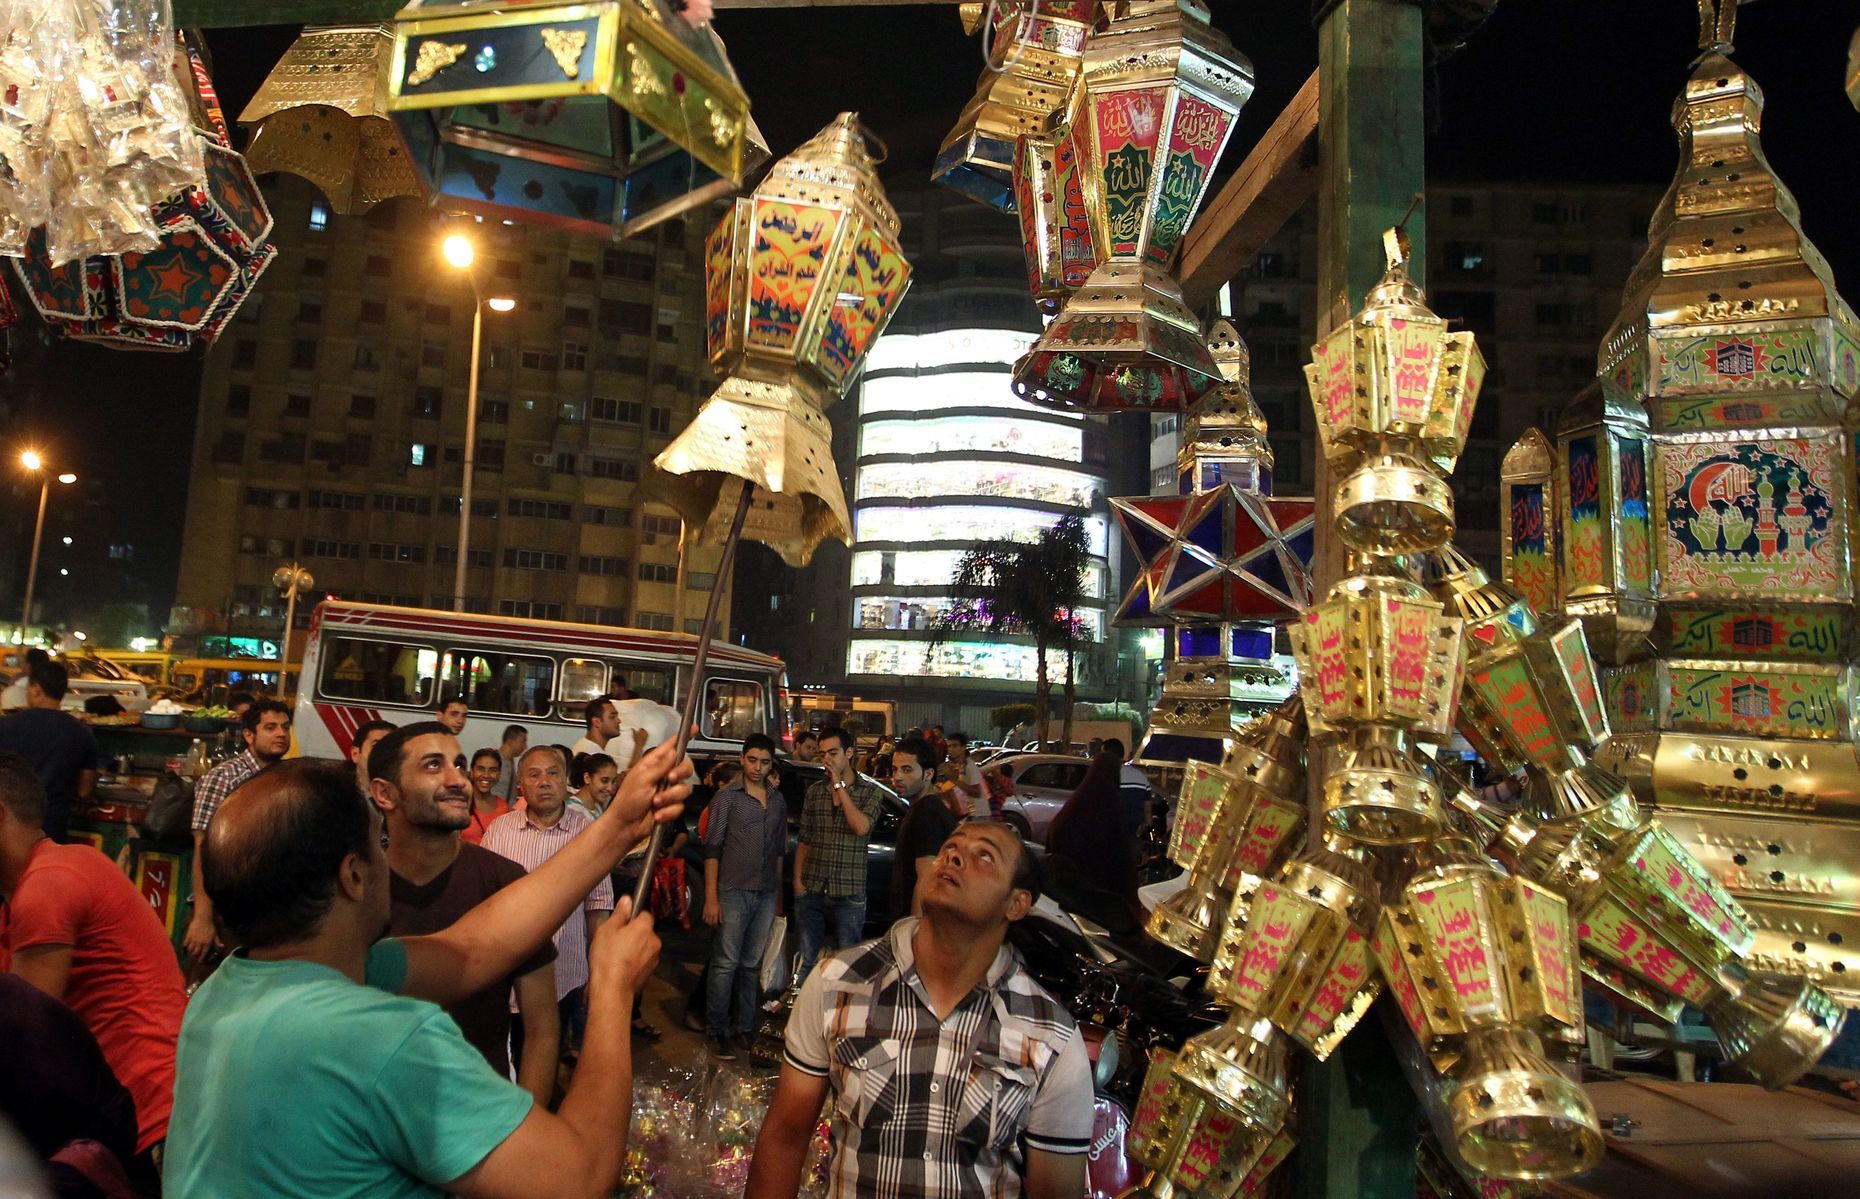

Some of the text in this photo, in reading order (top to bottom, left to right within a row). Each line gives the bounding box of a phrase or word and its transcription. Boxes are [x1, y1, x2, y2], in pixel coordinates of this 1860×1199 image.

[1112, 153, 1145, 191] الله
[1166, 165, 1197, 201] الله
[1769, 337, 1818, 378] الله
[1789, 620, 1838, 653] الله
[1788, 687, 1837, 728] الله
